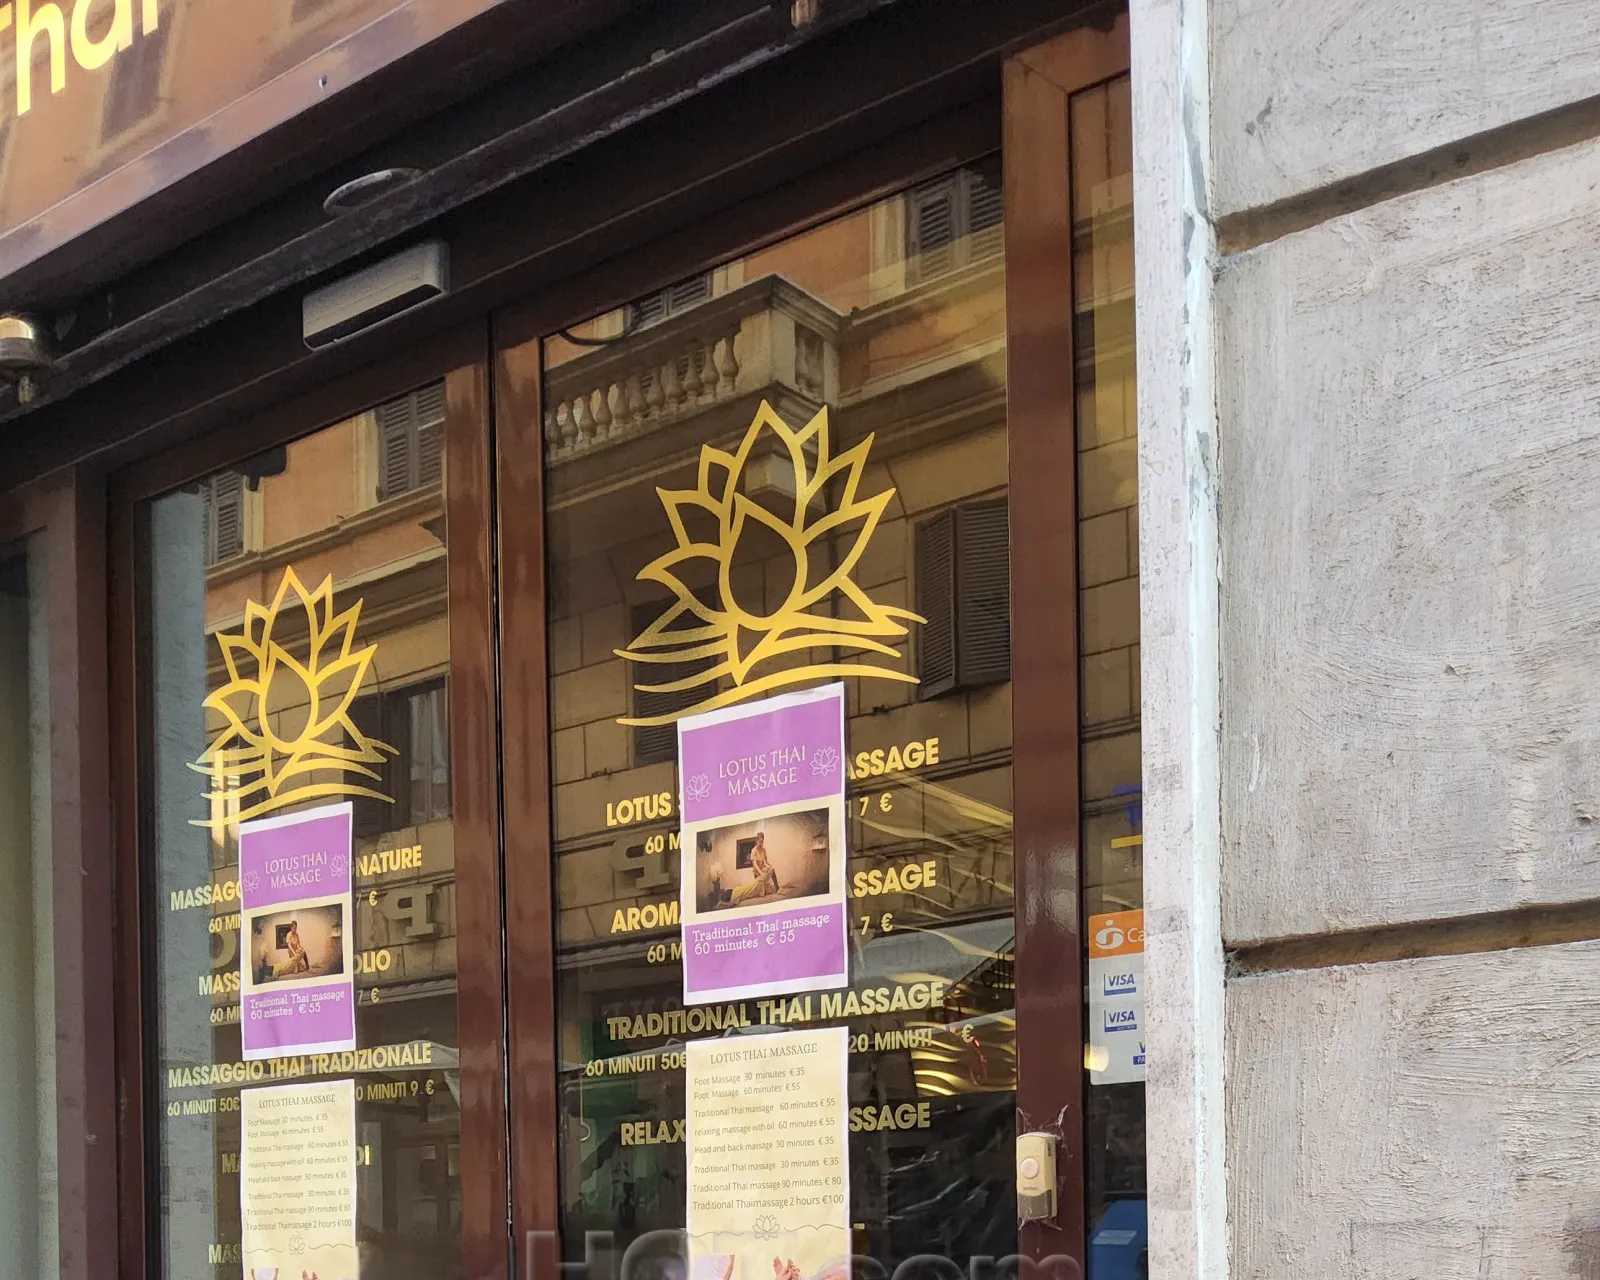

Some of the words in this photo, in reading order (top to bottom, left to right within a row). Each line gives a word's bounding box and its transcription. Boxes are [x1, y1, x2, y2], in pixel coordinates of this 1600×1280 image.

[719, 754, 766, 778] LOTUS
[770, 745, 805, 767] THAI
[607, 792, 671, 827] LOTUS
[848, 737, 939, 780] SSAGE
[728, 767, 797, 796] MASSAGE
[645, 835, 664, 854] 60
[265, 856, 299, 874] LOTUS
[302, 851, 326, 868] THAI
[170, 881, 242, 911] MASSAG
[356, 845, 421, 877] NATURE
[271, 869, 321, 888] MASSAGE
[611, 901, 681, 933] AROM
[847, 861, 936, 898] SSAGE
[209, 917, 222, 933] 60
[693, 923, 752, 942] Traditional
[756, 921, 779, 933] Thai
[783, 914, 829, 928] massage
[695, 943, 709, 955] 60
[715, 938, 758, 952] minutes
[780, 930, 794, 943] 55
[647, 944, 665, 963] 60
[1108, 974, 1134, 986] VISA
[291, 993, 309, 1004] Thai
[312, 991, 344, 1001] massage
[210, 1008, 224, 1023] 60
[251, 1010, 262, 1019] 60
[309, 1003, 320, 1012] 55
[607, 1003, 751, 1040] TRADITIONAL
[757, 995, 811, 1025] THAI
[821, 982, 944, 1019] MASSAGE
[1108, 1011, 1135, 1023] VISA
[586, 1059, 603, 1076] 60
[608, 1054, 655, 1075] MINUTI
[849, 1033, 869, 1053] 20
[710, 1052, 741, 1064] LOTUS
[743, 1049, 766, 1060] THAI
[770, 1043, 817, 1057] MASSAGE
[169, 1061, 263, 1088] MASSAGGIO
[268, 1056, 305, 1078] THAI
[310, 1042, 432, 1075] TRADIZIONALE
[695, 1078, 710, 1086] Foot
[712, 1075, 740, 1084] Massage
[744, 1073, 752, 1081] 30
[756, 1070, 786, 1079] minutes
[167, 1101, 179, 1116] 60
[183, 1099, 216, 1115] MINUTI
[368, 1082, 406, 1100] MINUTI
[621, 1119, 686, 1146] RELAX
[849, 1102, 930, 1132] SSAGE
[722, 1125, 751, 1134] massage
[779, 1121, 787, 1129] 60
[790, 1119, 817, 1128] minutes
[695, 1146, 711, 1154] Head
[713, 1144, 725, 1152] and
[728, 1143, 743, 1151] back
[746, 1142, 772, 1151] massage
[776, 1140, 784, 1148] 30
[787, 1139, 814, 1148] minutes
[693, 1184, 730, 1193] Traditional
[733, 1182, 748, 1190] Thai
[750, 1181, 780, 1190] massage
[792, 1178, 822, 1187] minutes
[693, 1200, 733, 1210] Traditional
[796, 1196, 820, 1205] hours
